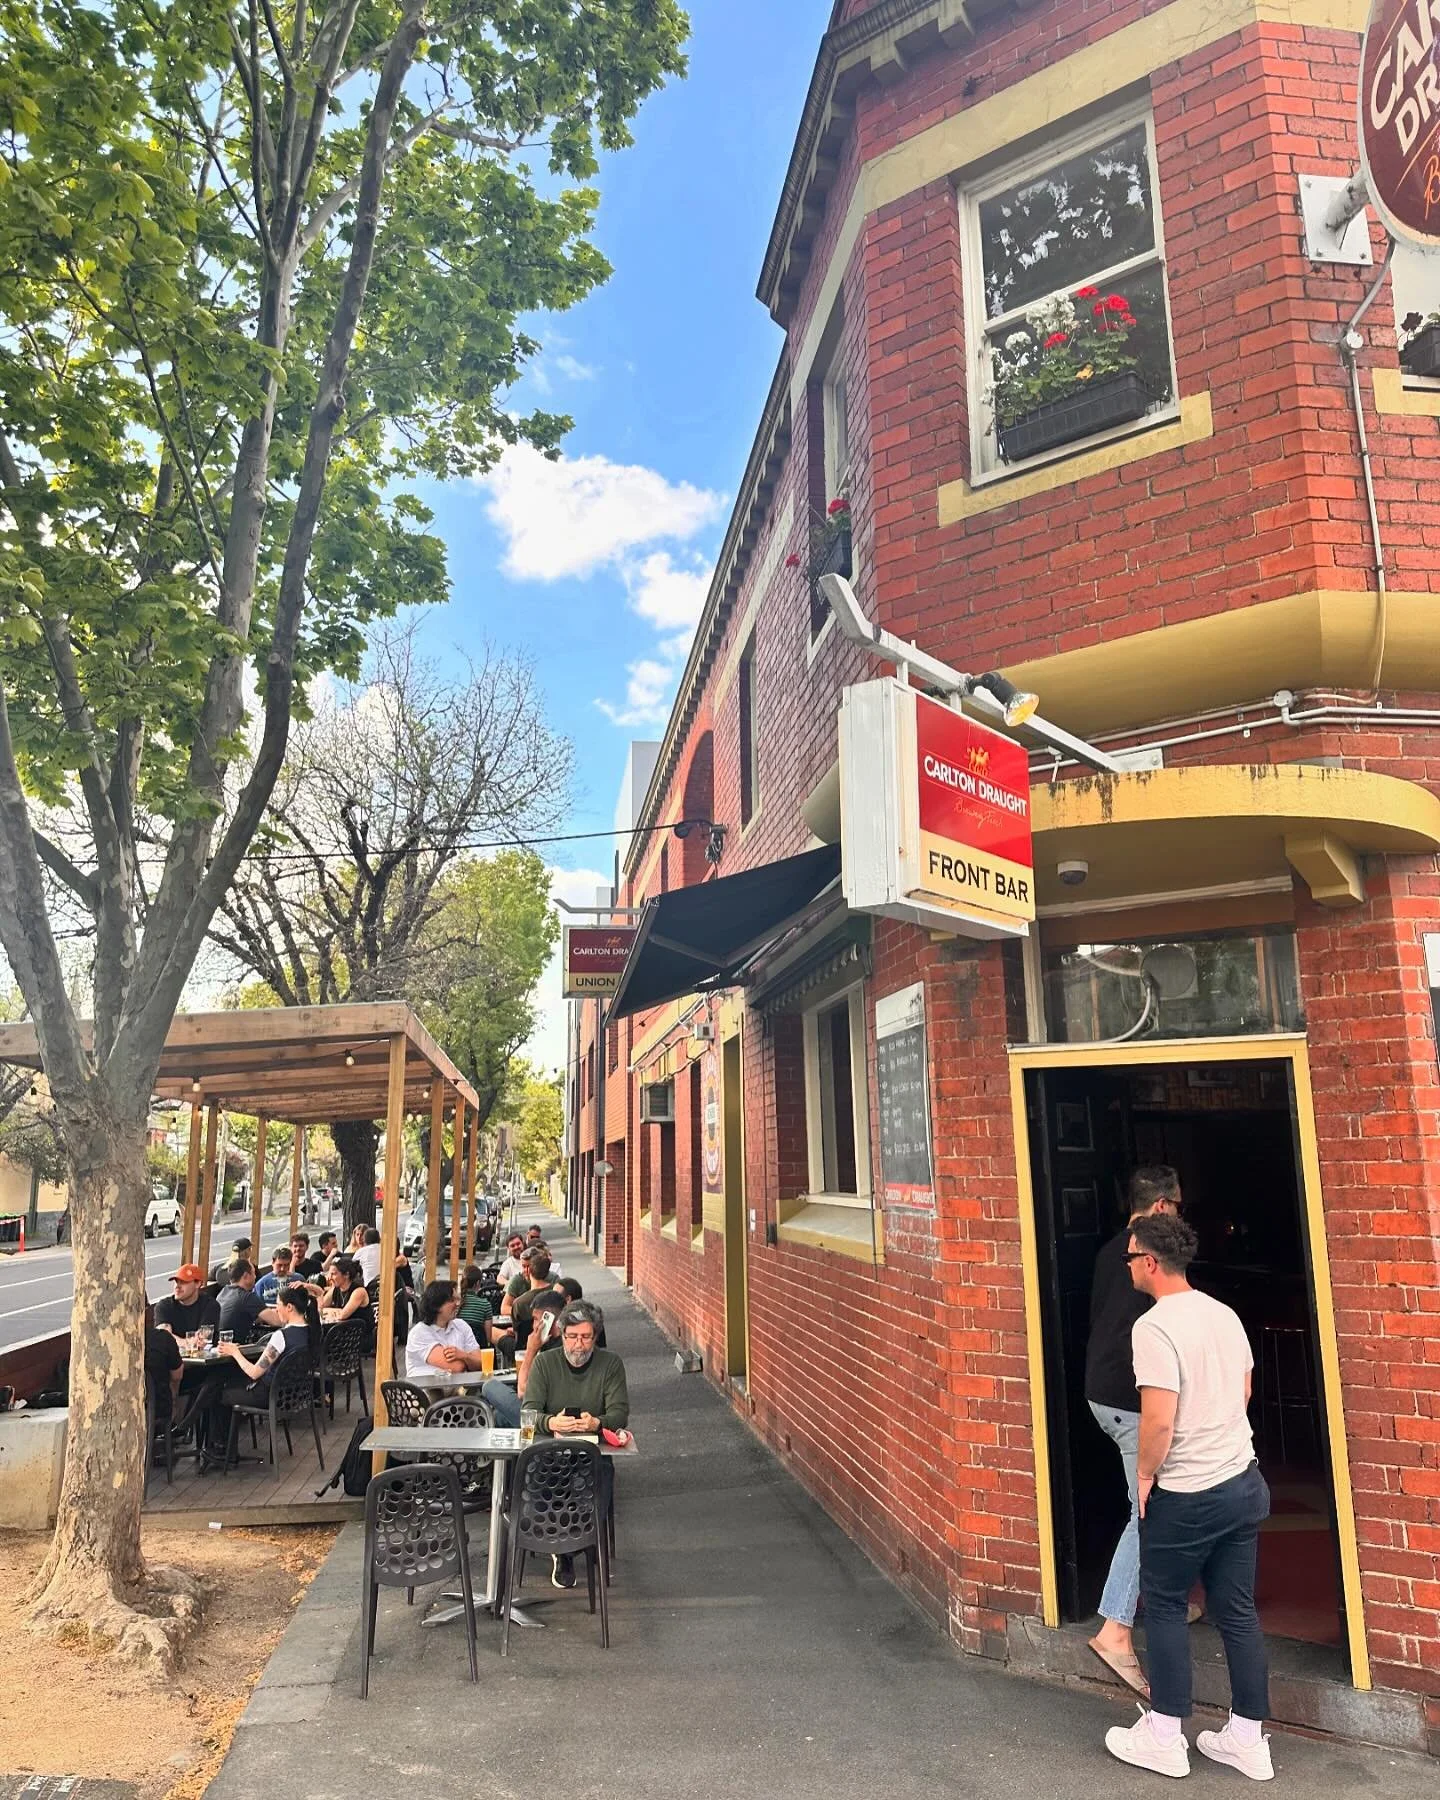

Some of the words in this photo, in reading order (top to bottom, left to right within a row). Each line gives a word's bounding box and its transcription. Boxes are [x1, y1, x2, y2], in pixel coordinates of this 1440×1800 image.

[924, 754, 976, 794] CARLTON
[978, 782, 1027, 817] DRAUGHT
[929, 850, 990, 891] FRONT
[995, 872, 1029, 903] BAR
[573, 947, 610, 956] CARLTON
[575, 977, 615, 987] UNION
